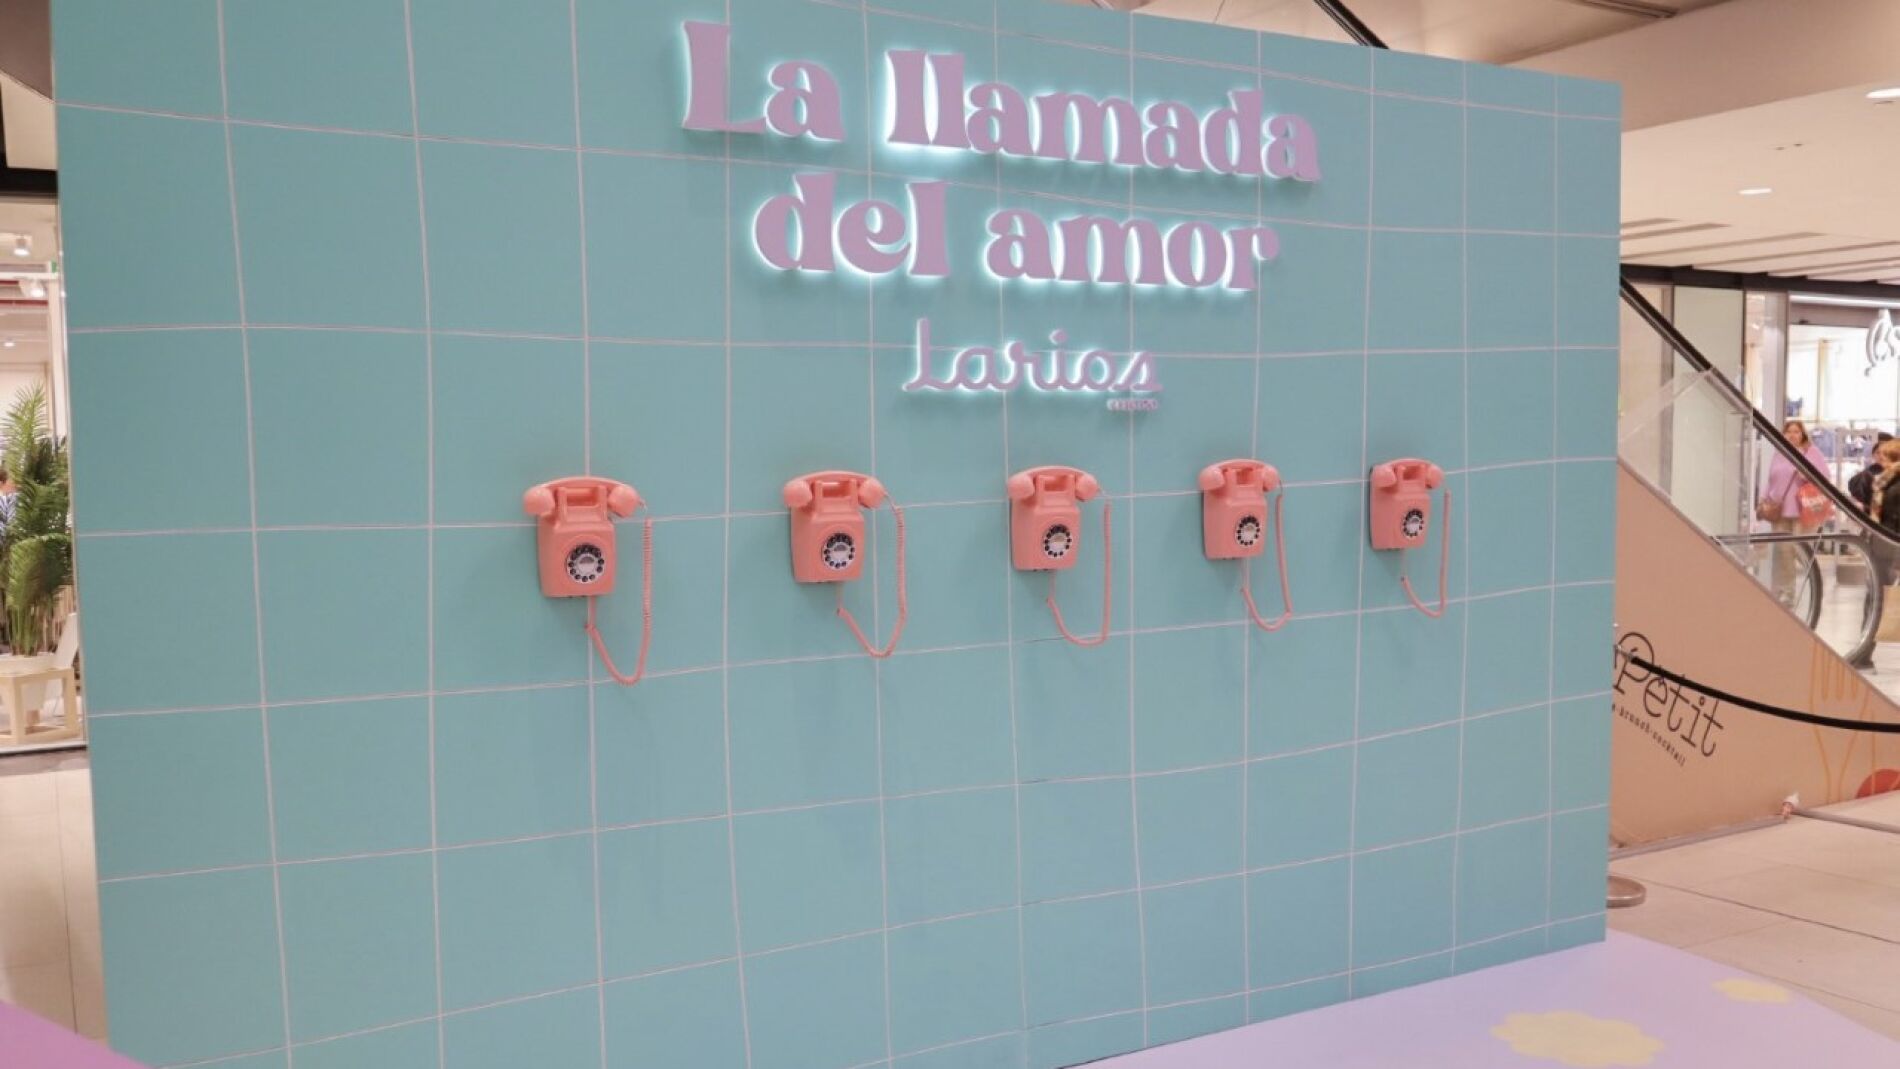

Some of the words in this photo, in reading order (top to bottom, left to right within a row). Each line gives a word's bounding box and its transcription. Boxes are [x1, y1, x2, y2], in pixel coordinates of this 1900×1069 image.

[682, 20, 846, 141] La
[885, 49, 1321, 182] llamada
[753, 172, 951, 277] del
[984, 208, 1281, 291] amor
[902, 317, 1164, 392] Larios
